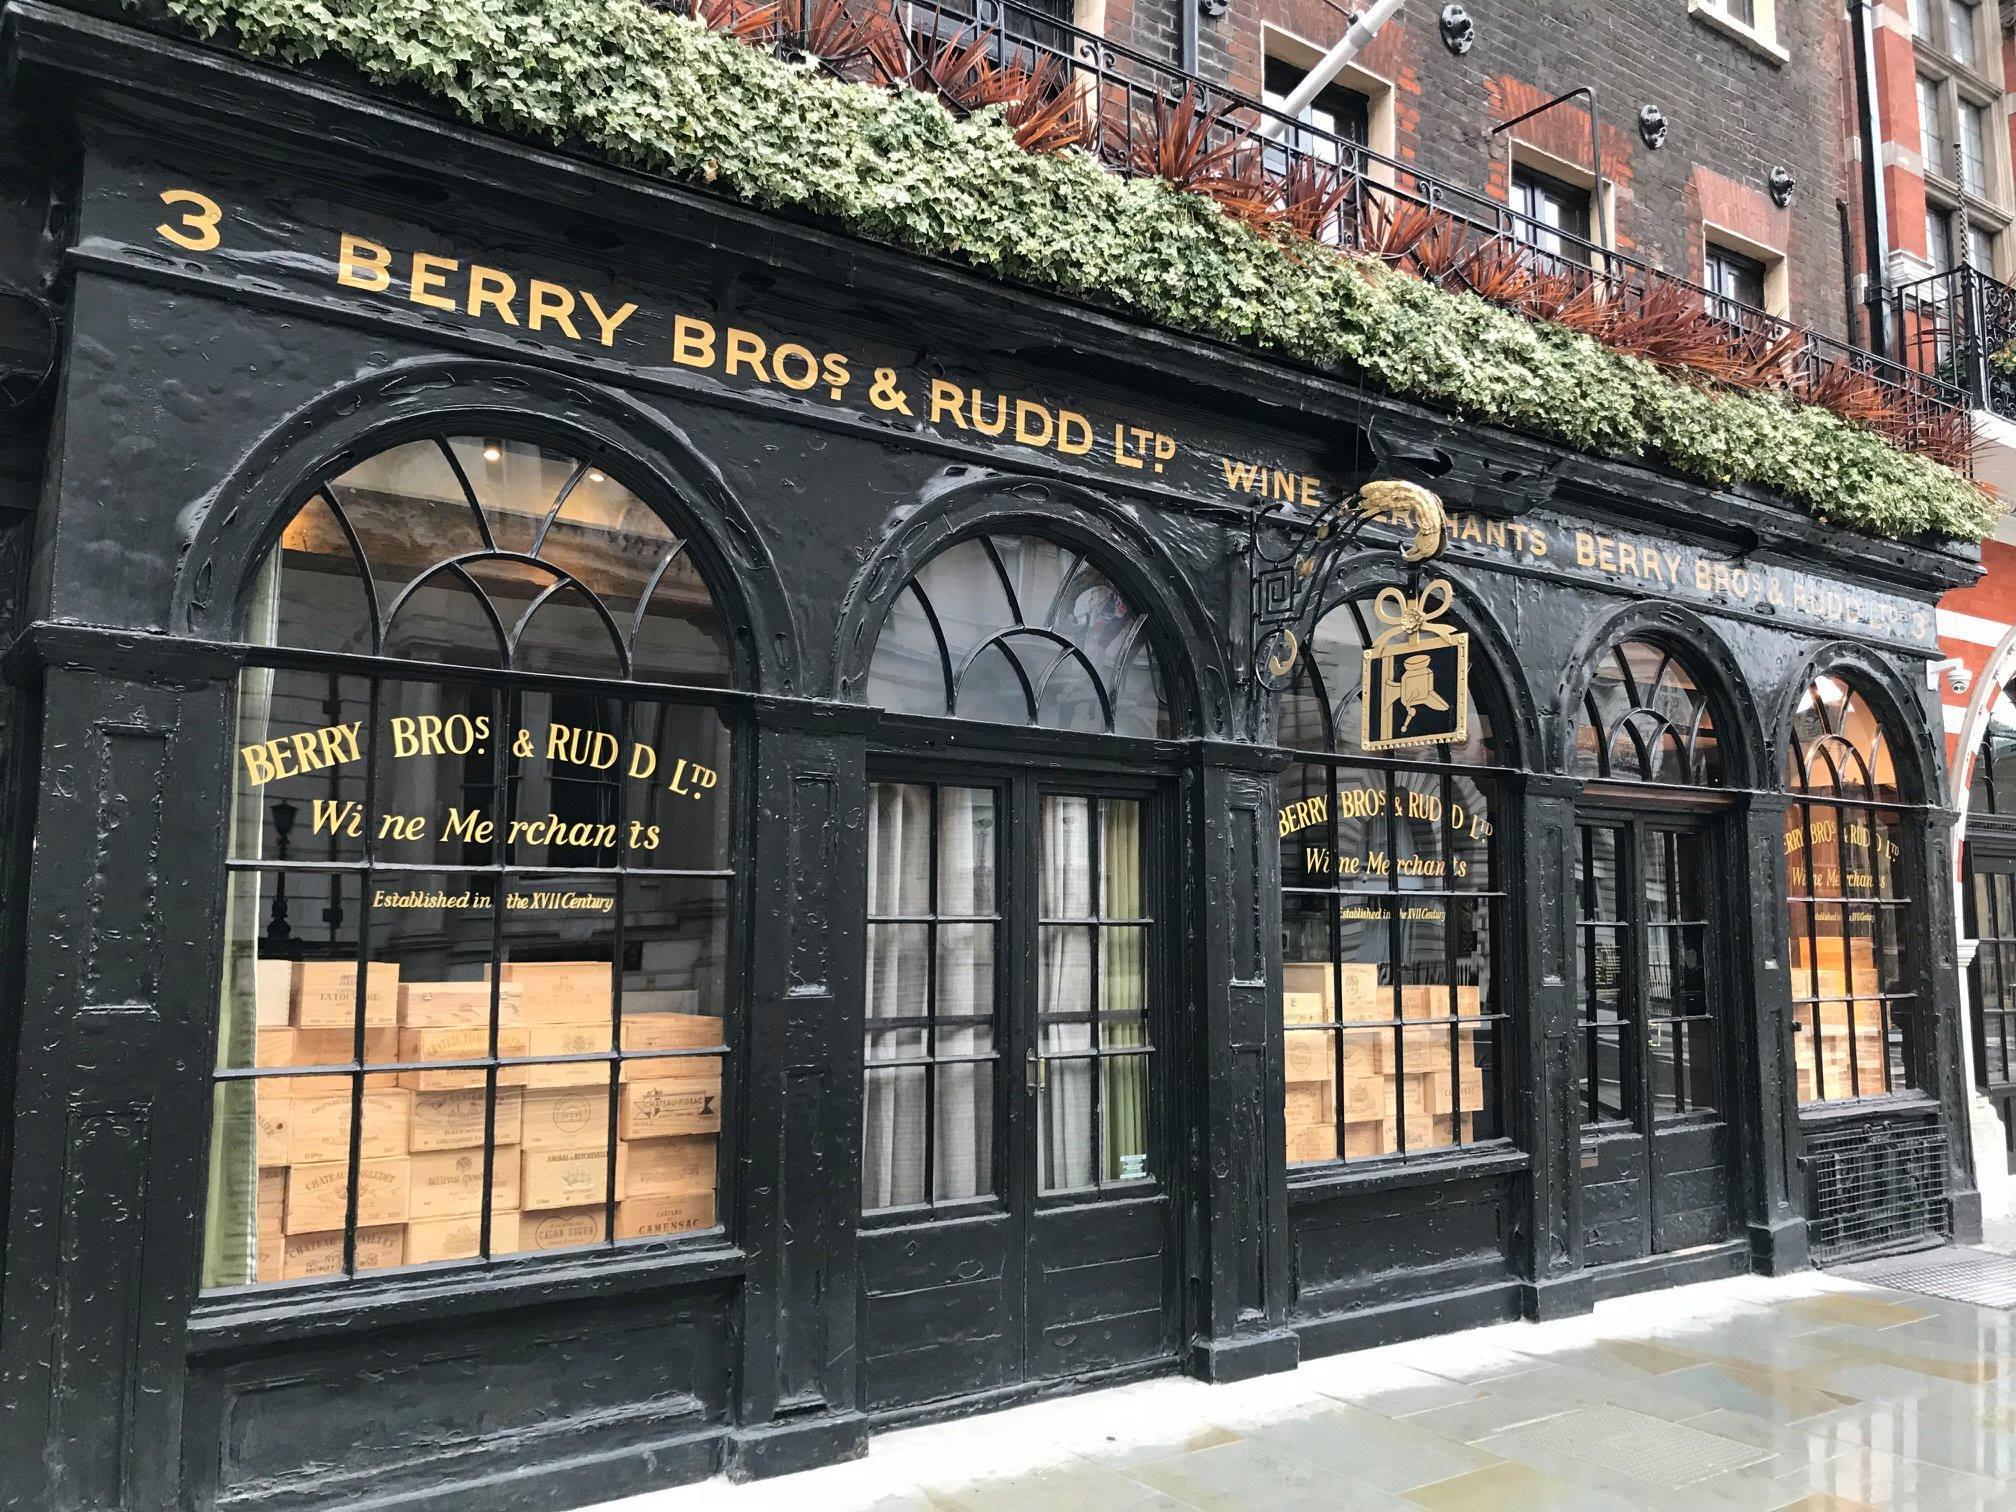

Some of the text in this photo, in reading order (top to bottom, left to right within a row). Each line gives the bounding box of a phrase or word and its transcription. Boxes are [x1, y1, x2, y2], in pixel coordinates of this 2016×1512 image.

[156, 189, 223, 252] 3
[338, 233, 638, 346] BERRY
[869, 366, 912, 416] &
[930, 378, 1094, 456] RUDD
[1222, 457, 1321, 507] WINE
[1372, 510, 1548, 556] RHANTS
[1575, 532, 1681, 584] BERRY
[1768, 576, 1784, 606] &
[241, 721, 364, 786] BERRY
[513, 728, 535, 758] &
[1279, 794, 1328, 838] BERRY
[1395, 796, 1403, 816] &
[1783, 826, 1805, 855] RRY
[373, 890, 614, 913] Established in the XVII Century
[1399, 908, 1407, 920] he
[1422, 907, 1447, 922] Century
[638, 1218, 700, 1235] CAMENSAC
